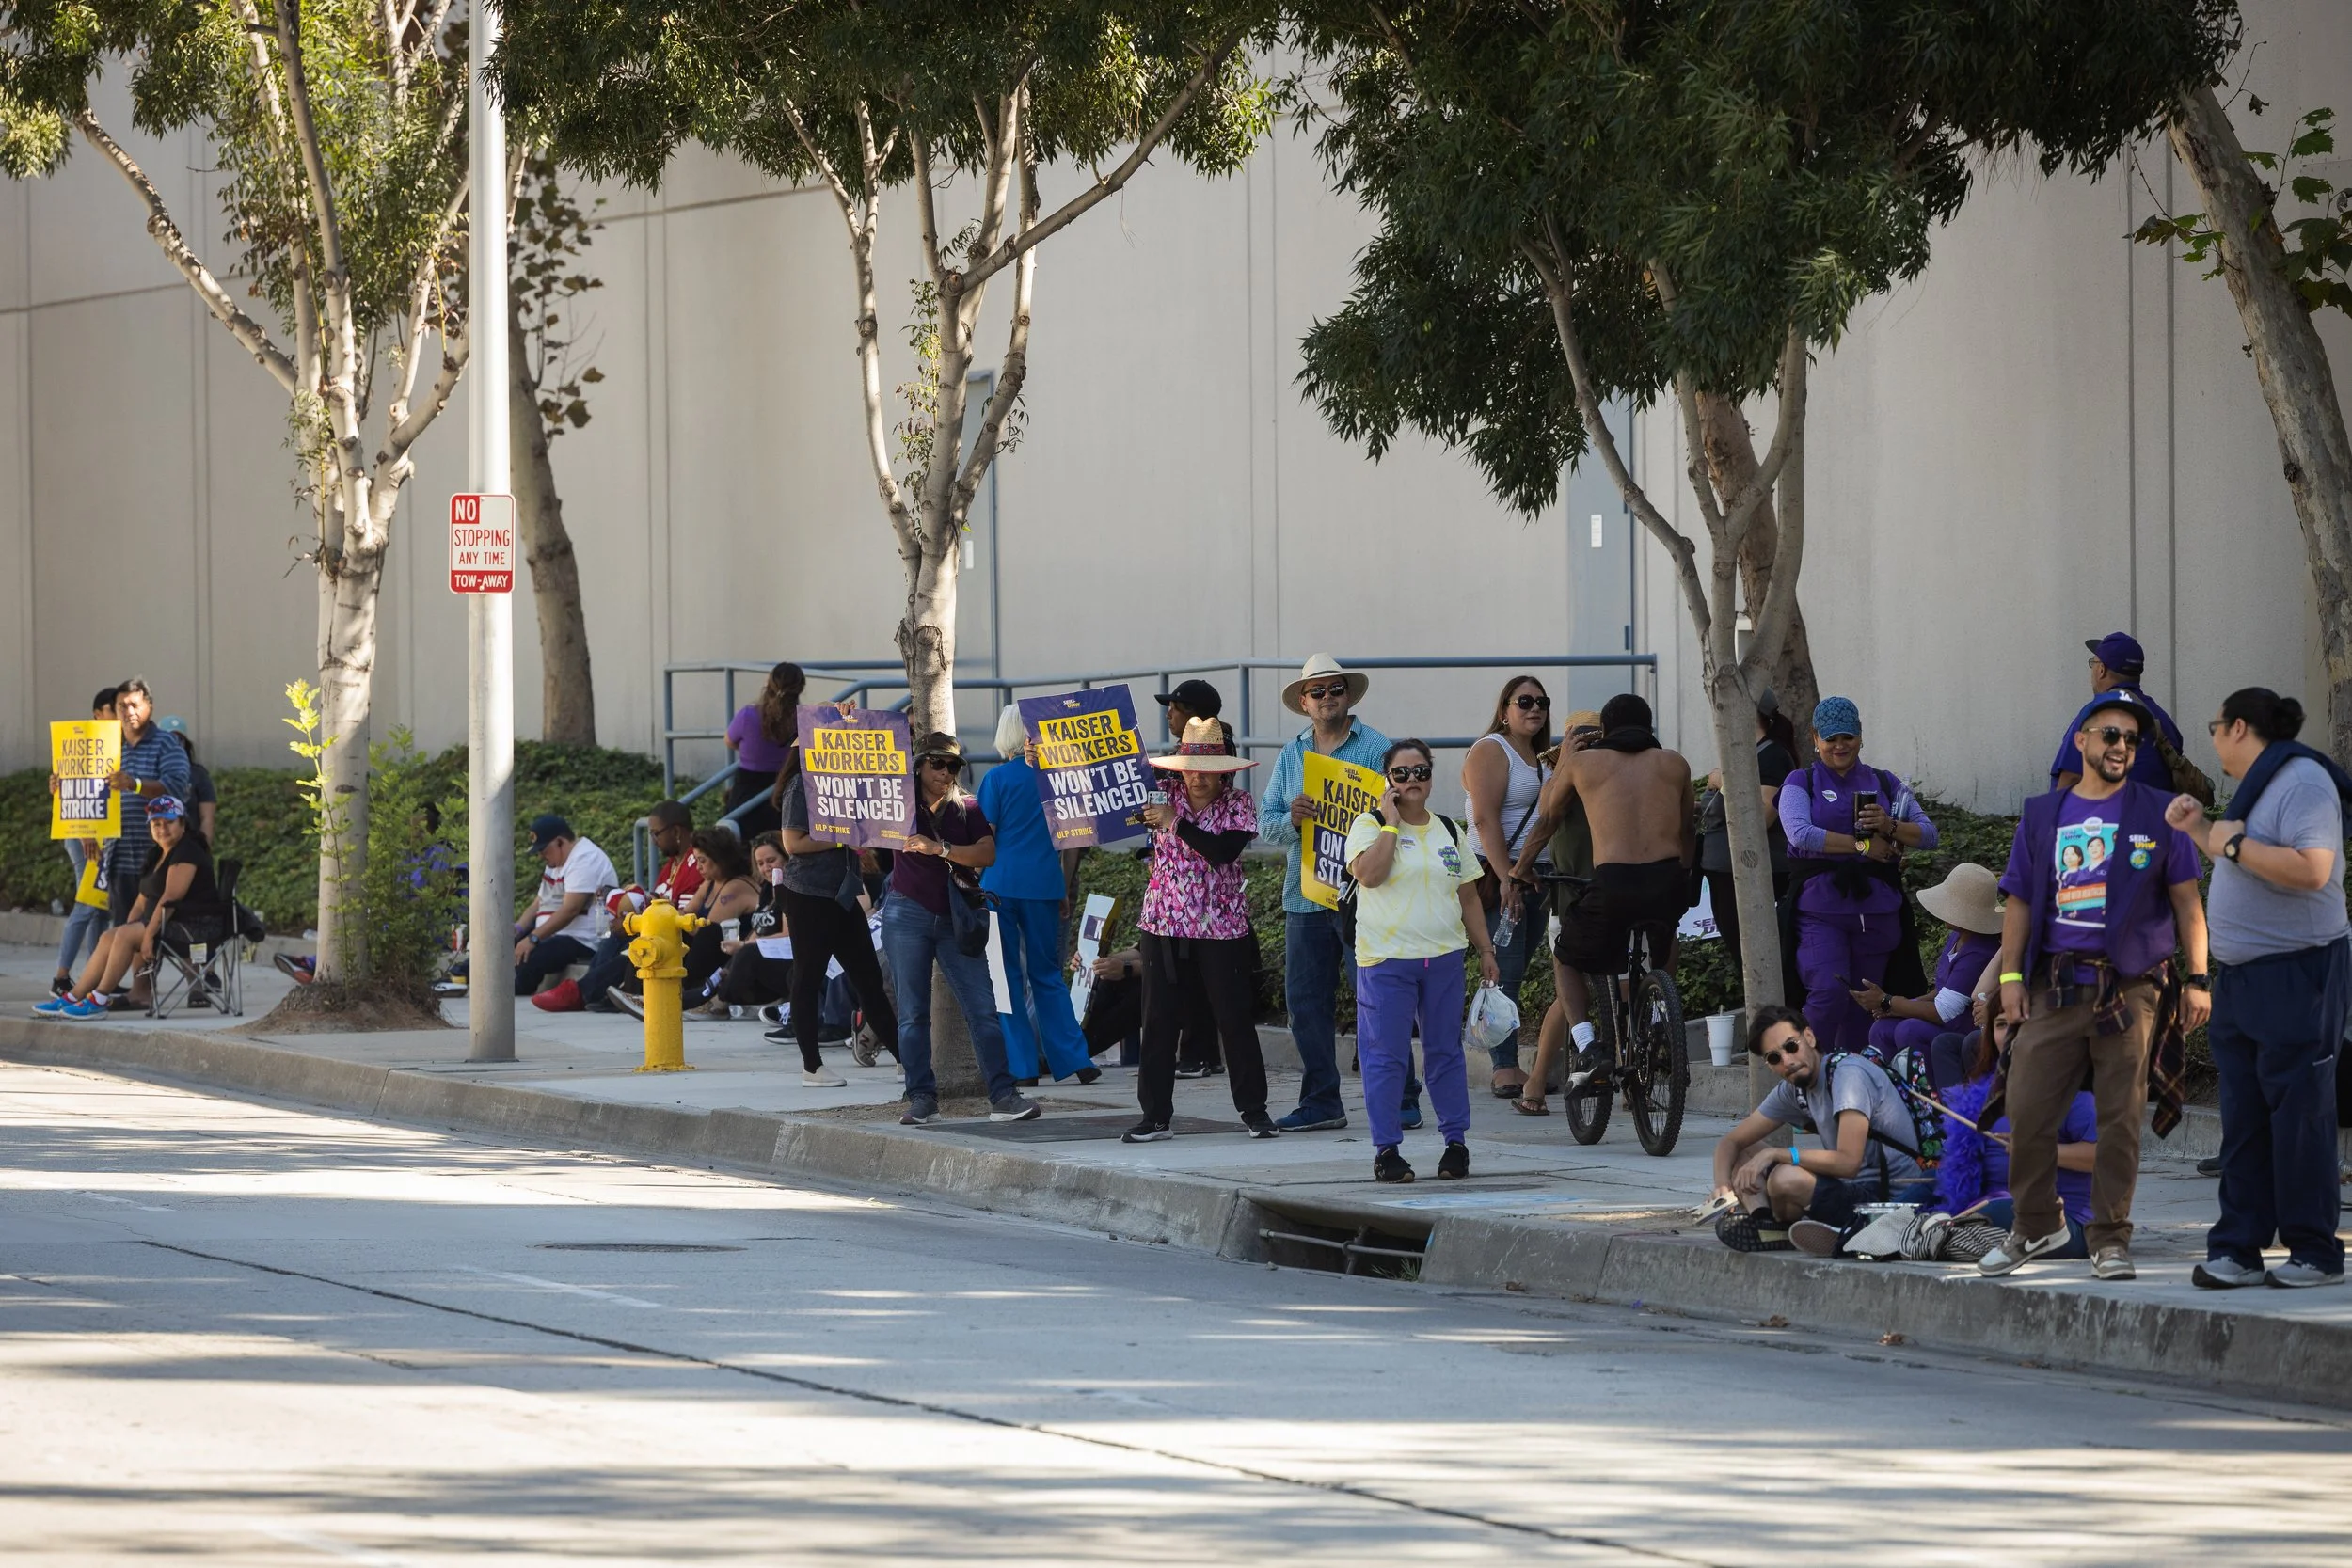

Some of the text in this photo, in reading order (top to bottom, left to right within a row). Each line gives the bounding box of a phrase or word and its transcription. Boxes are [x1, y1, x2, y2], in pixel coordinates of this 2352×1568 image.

[455, 499, 477, 521] NO
[454, 529, 510, 547] STOPPING
[458, 551, 505, 565] ANY TIME
[454, 574, 509, 588] TOW-AWAY
[1046, 714, 1115, 743] KAISER
[62, 738, 104, 756] KAISER
[821, 732, 887, 751] KAISER
[1041, 734, 1133, 766] WORKERS
[56, 757, 115, 776] WORKERS
[811, 752, 900, 772] WORKERS
[813, 775, 904, 800] WON'T BE
[1047, 758, 1142, 797] WON'T BE
[61, 778, 105, 799] ON ULP
[61, 799, 105, 819] STRIKE
[817, 797, 905, 822] SILENCED
[1053, 782, 1148, 821] SILENCED
[815, 823, 850, 834] ULP STRIKE
[1056, 826, 1093, 840] ULP STRIKE
[1320, 830, 1343, 861] ON
